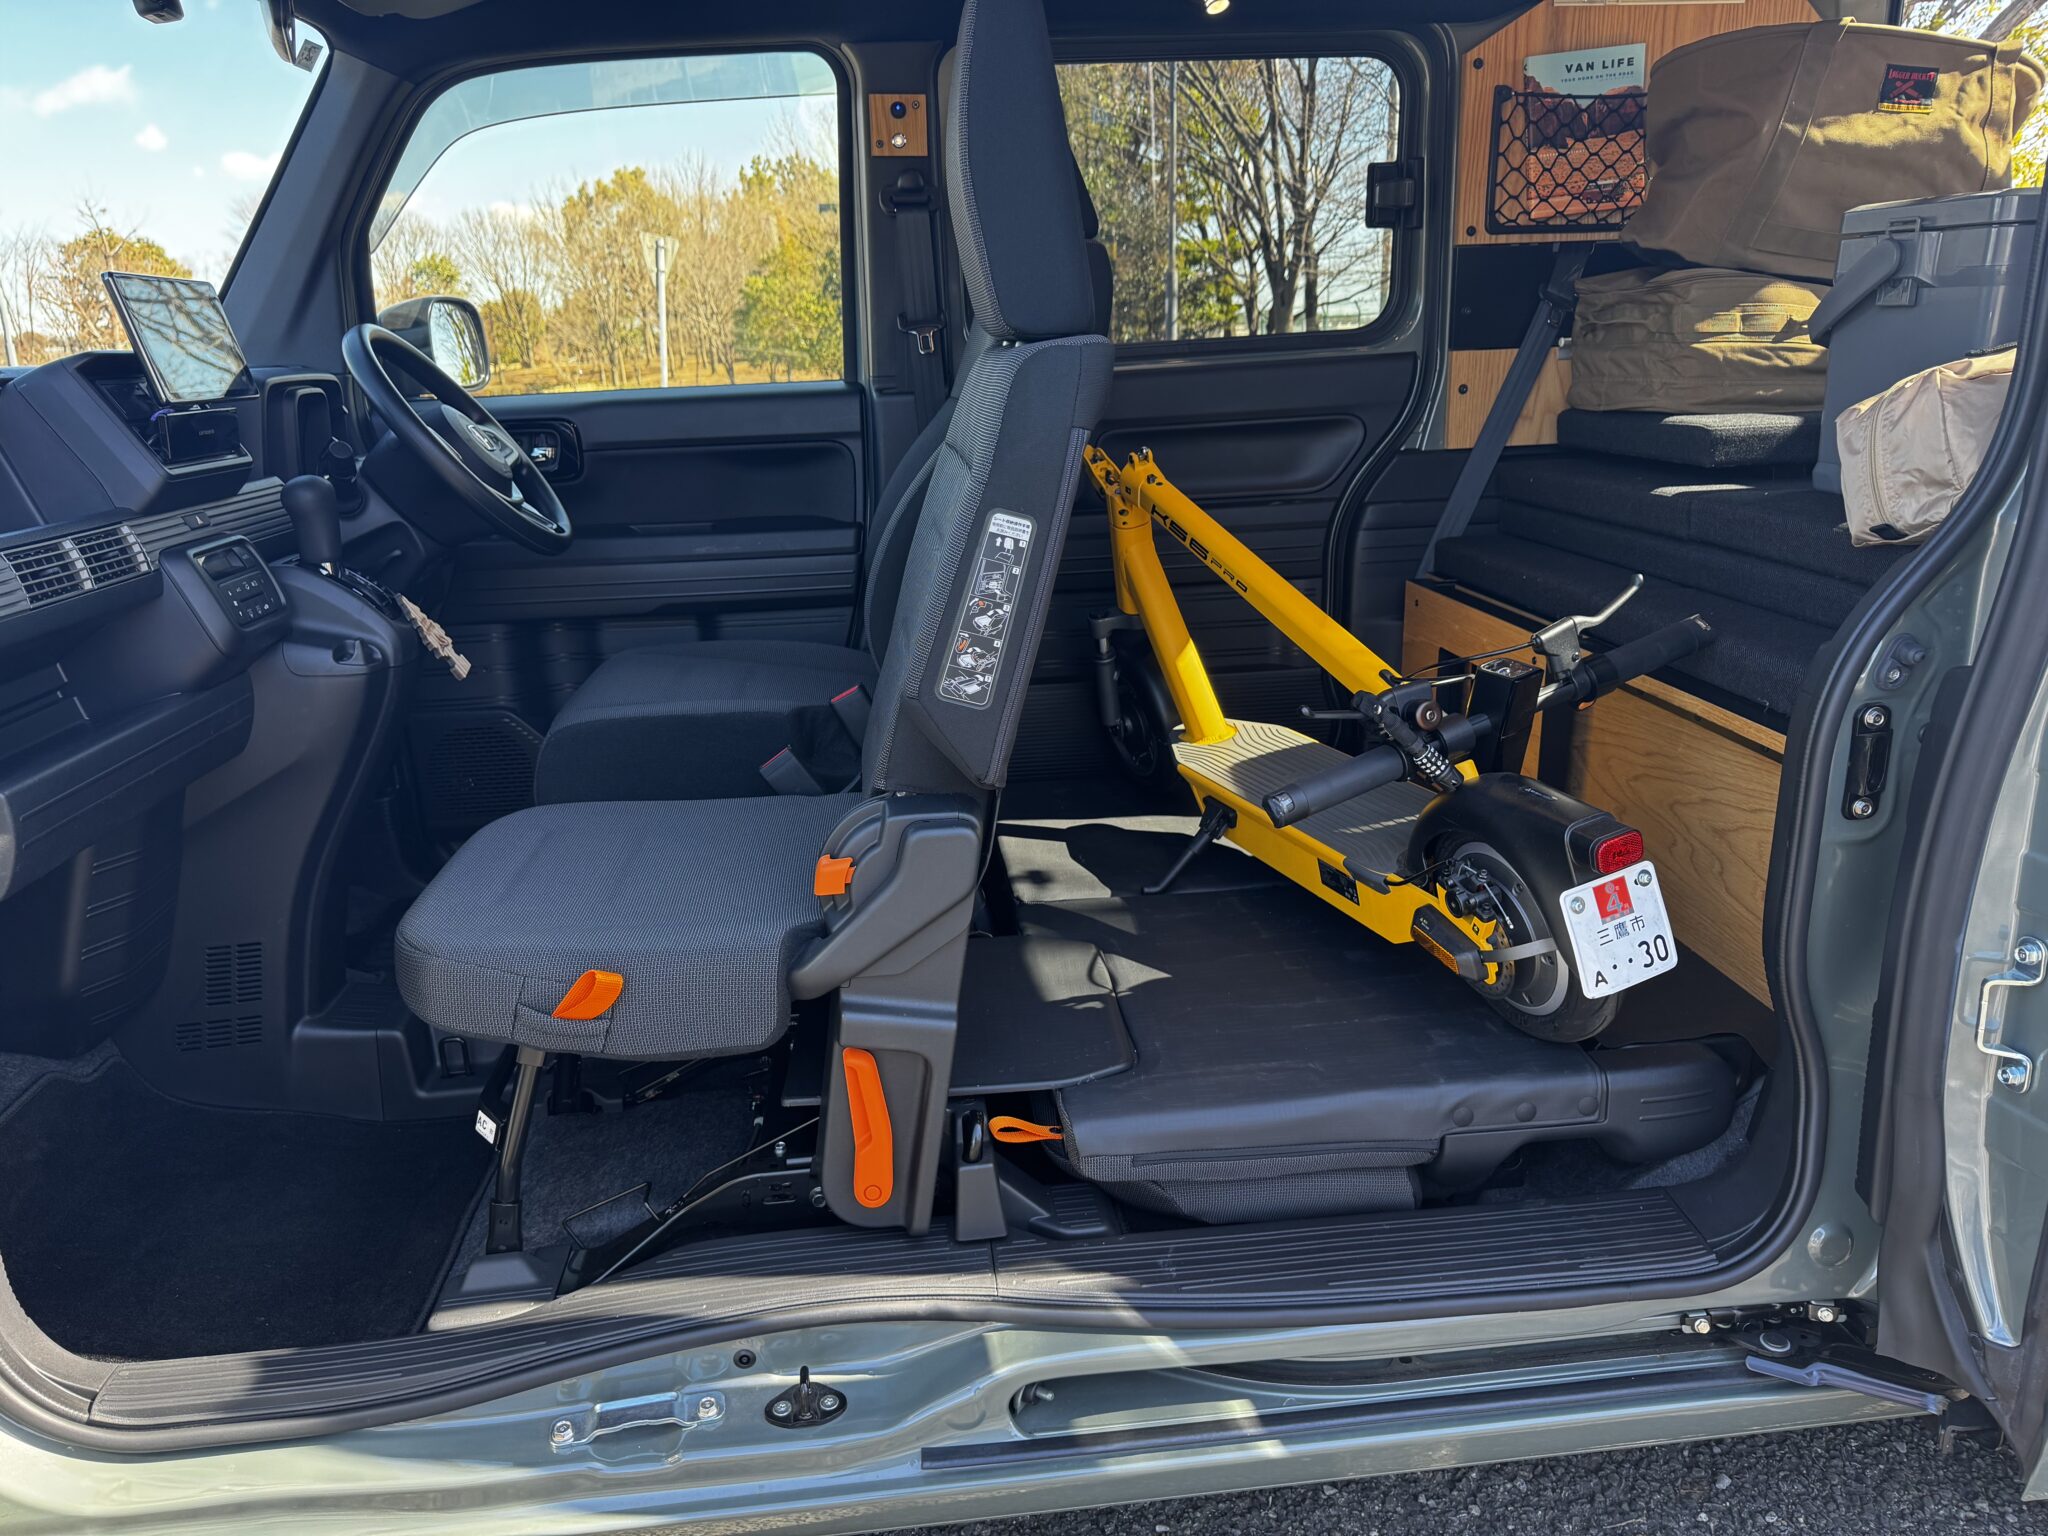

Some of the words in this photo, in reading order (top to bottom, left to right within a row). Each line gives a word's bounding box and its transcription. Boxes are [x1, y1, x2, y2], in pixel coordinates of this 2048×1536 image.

[1565, 61, 1595, 74] VAN
[1602, 57, 1635, 70] LIFE
[1597, 915, 1646, 946] 三鷹市
